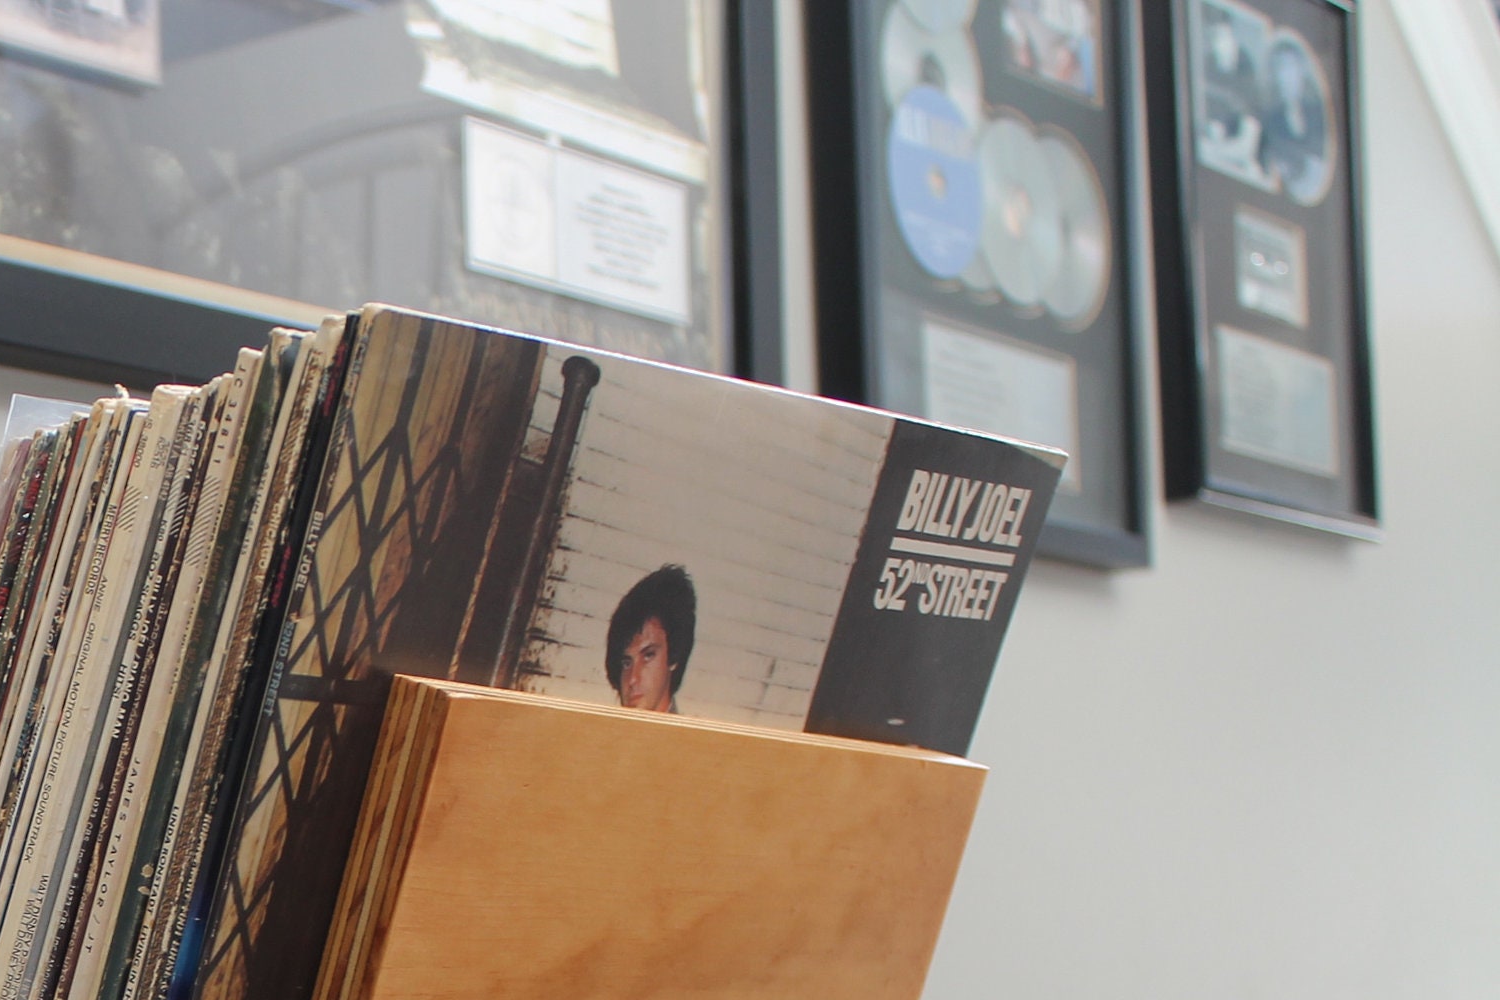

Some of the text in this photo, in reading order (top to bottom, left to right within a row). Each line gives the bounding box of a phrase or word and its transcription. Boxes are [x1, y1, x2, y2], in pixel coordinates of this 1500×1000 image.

[99, 504, 117, 541] MERRY
[896, 469, 1032, 547] BILLY JOEL
[257, 502, 283, 568] CHICAGO
[304, 511, 324, 553] BILLY
[84, 544, 106, 595] RECORDS
[145, 552, 161, 581] BOZ
[294, 554, 313, 591] JOEL
[146, 574, 163, 612] BILLY
[918, 564, 1008, 621] STREET
[128, 586, 151, 640] SCAGGS
[137, 619, 151, 645] JOEL
[277, 621, 295, 656] 52ND
[121, 661, 138, 701] PIANO
[262, 660, 285, 717] STREET
[23, 575, 109, 863] ANNIE ORIGINAL MOTION PICTURE SOUNDTRACK
[110, 706, 126, 738] MAN
[118, 757, 141, 821] JAMES
[164, 806, 179, 843] LINDA
[34, 875, 48, 903] WALT
[95, 833, 121, 907] TAYLOR
[146, 848, 169, 914] RONSTADT
[20, 899, 34, 925] WALT
[21, 905, 40, 948] DISNEY
[7, 929, 26, 969] DISNEY
[83, 933, 95, 953] JT
[133, 925, 149, 966] LIVING
[128, 969, 137, 984] IN
